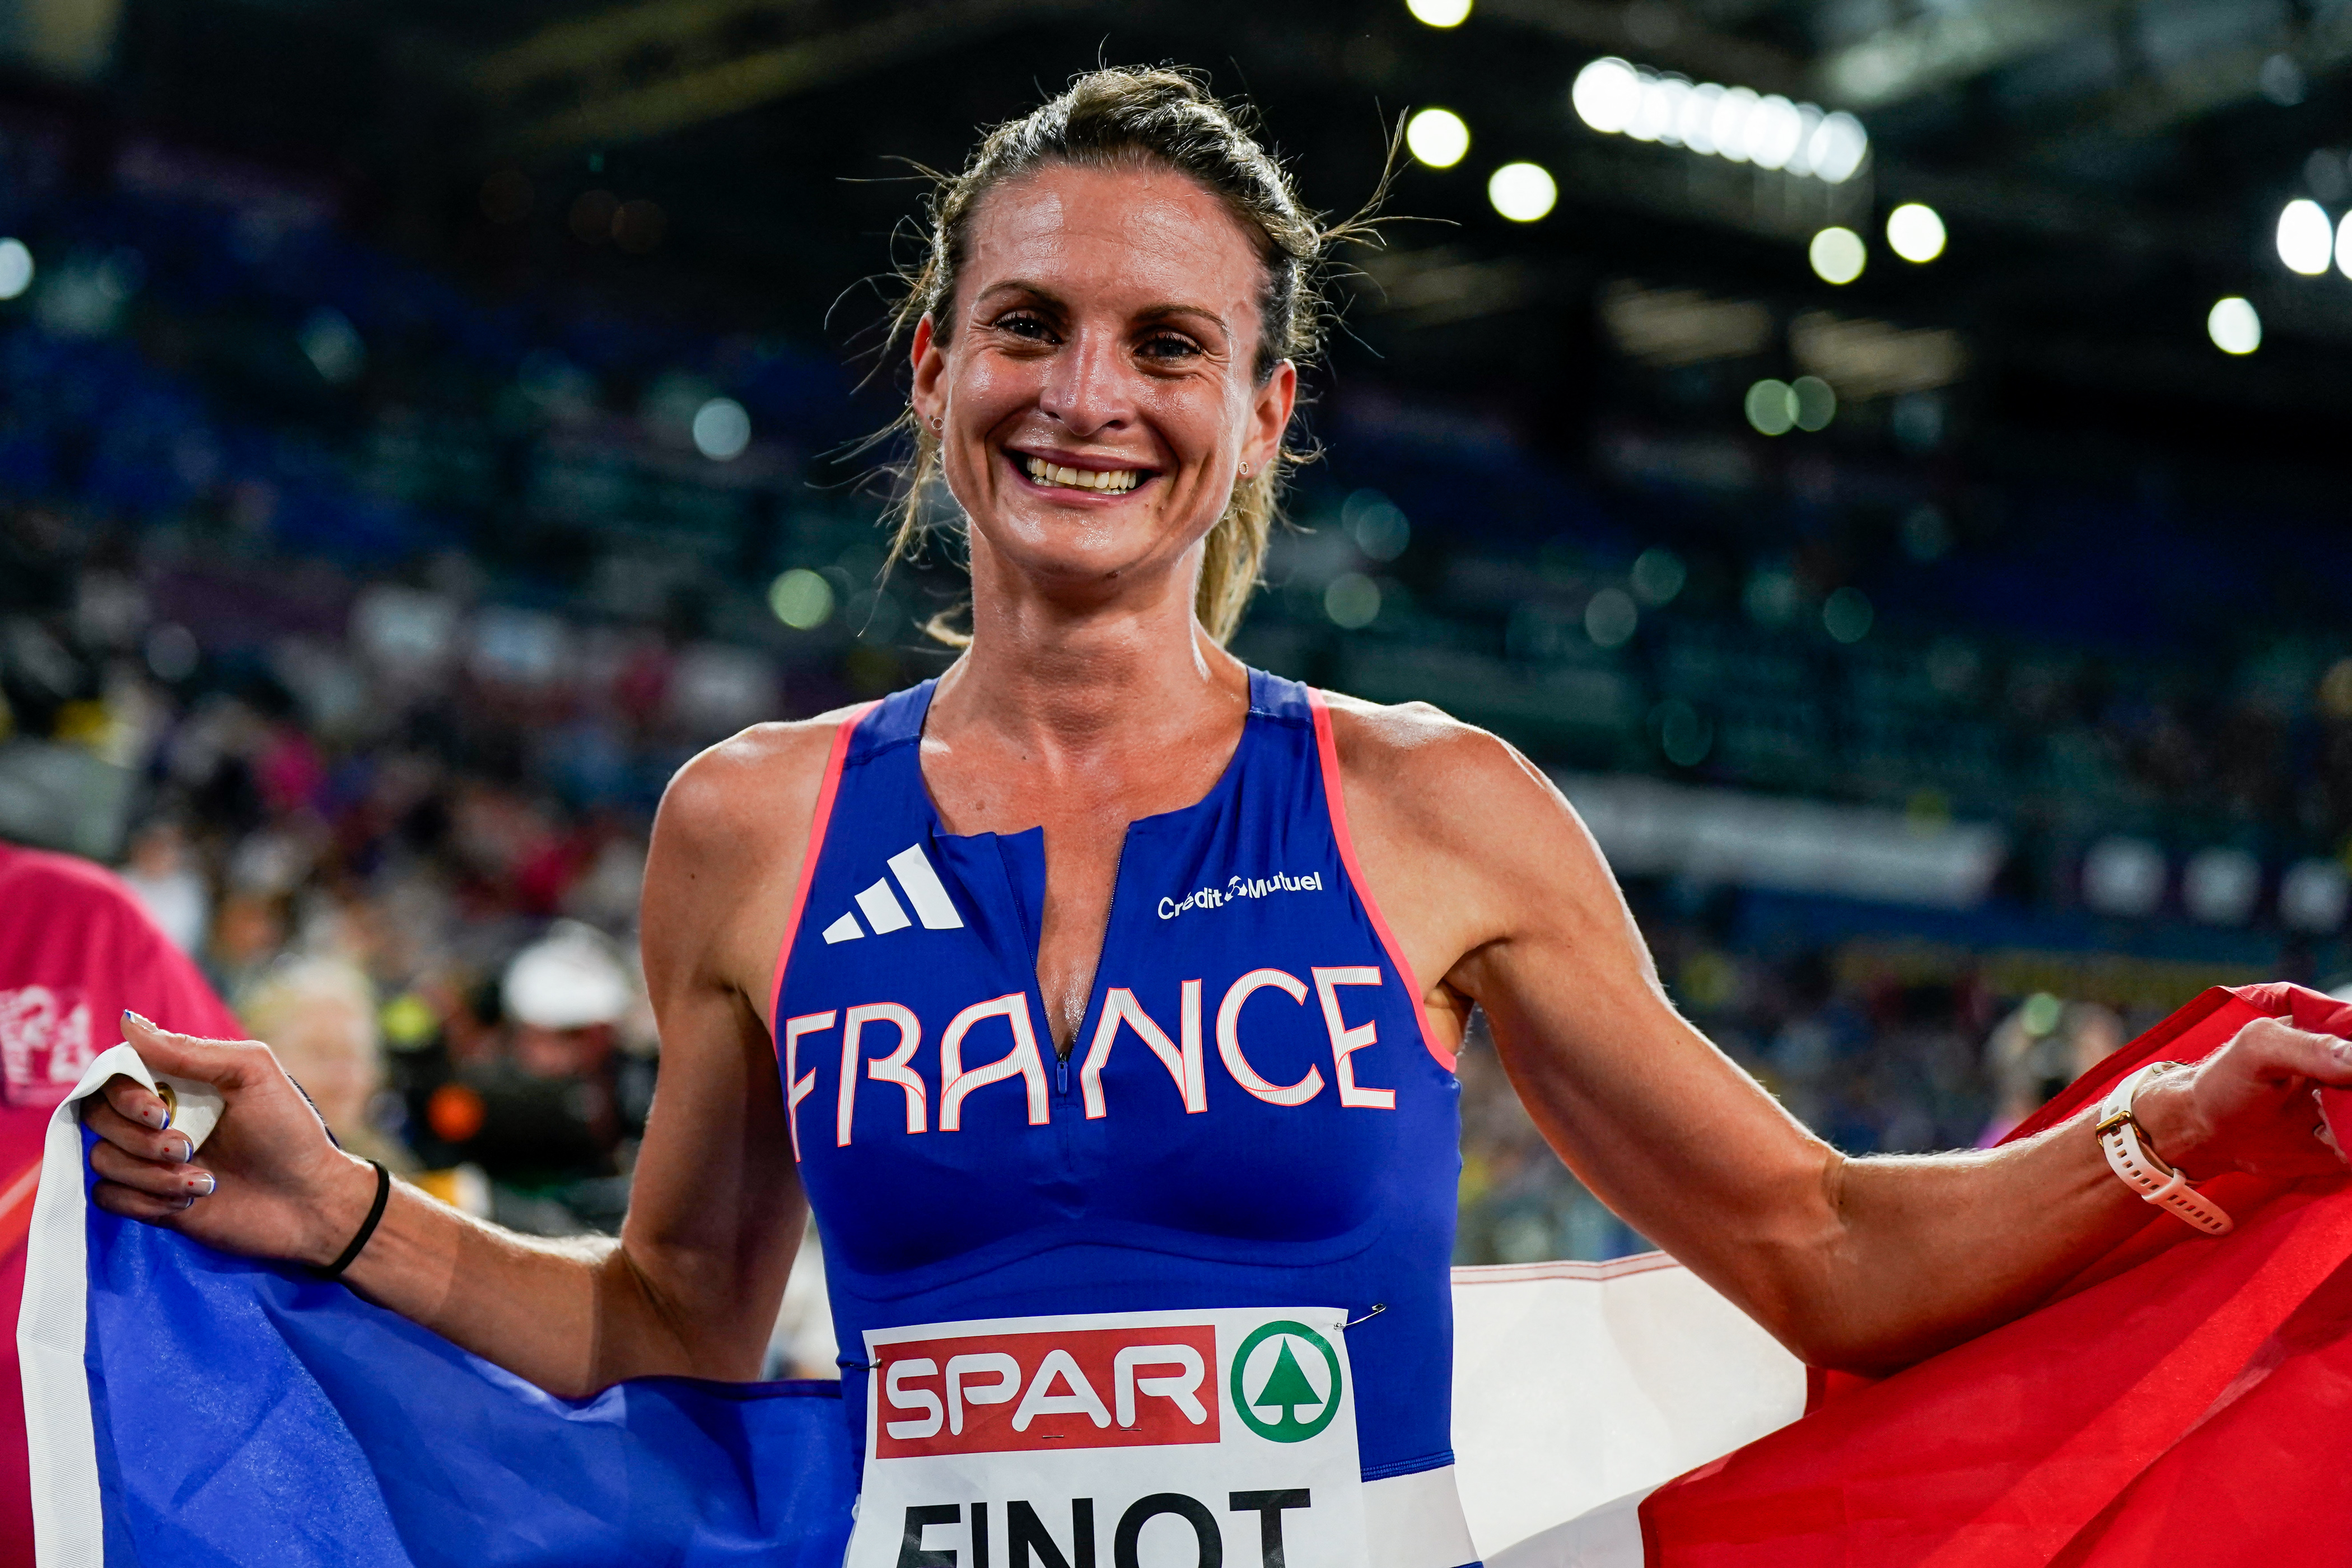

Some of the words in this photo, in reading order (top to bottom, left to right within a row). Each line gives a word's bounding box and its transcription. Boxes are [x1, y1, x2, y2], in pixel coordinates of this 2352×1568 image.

[1158, 892, 1223, 920] Crédit
[1248, 871, 1323, 898] Mutuel
[786, 965, 1396, 1163] FRANCE
[886, 1345, 1207, 1440] SPAR
[896, 1488, 1311, 1568] FINOT
